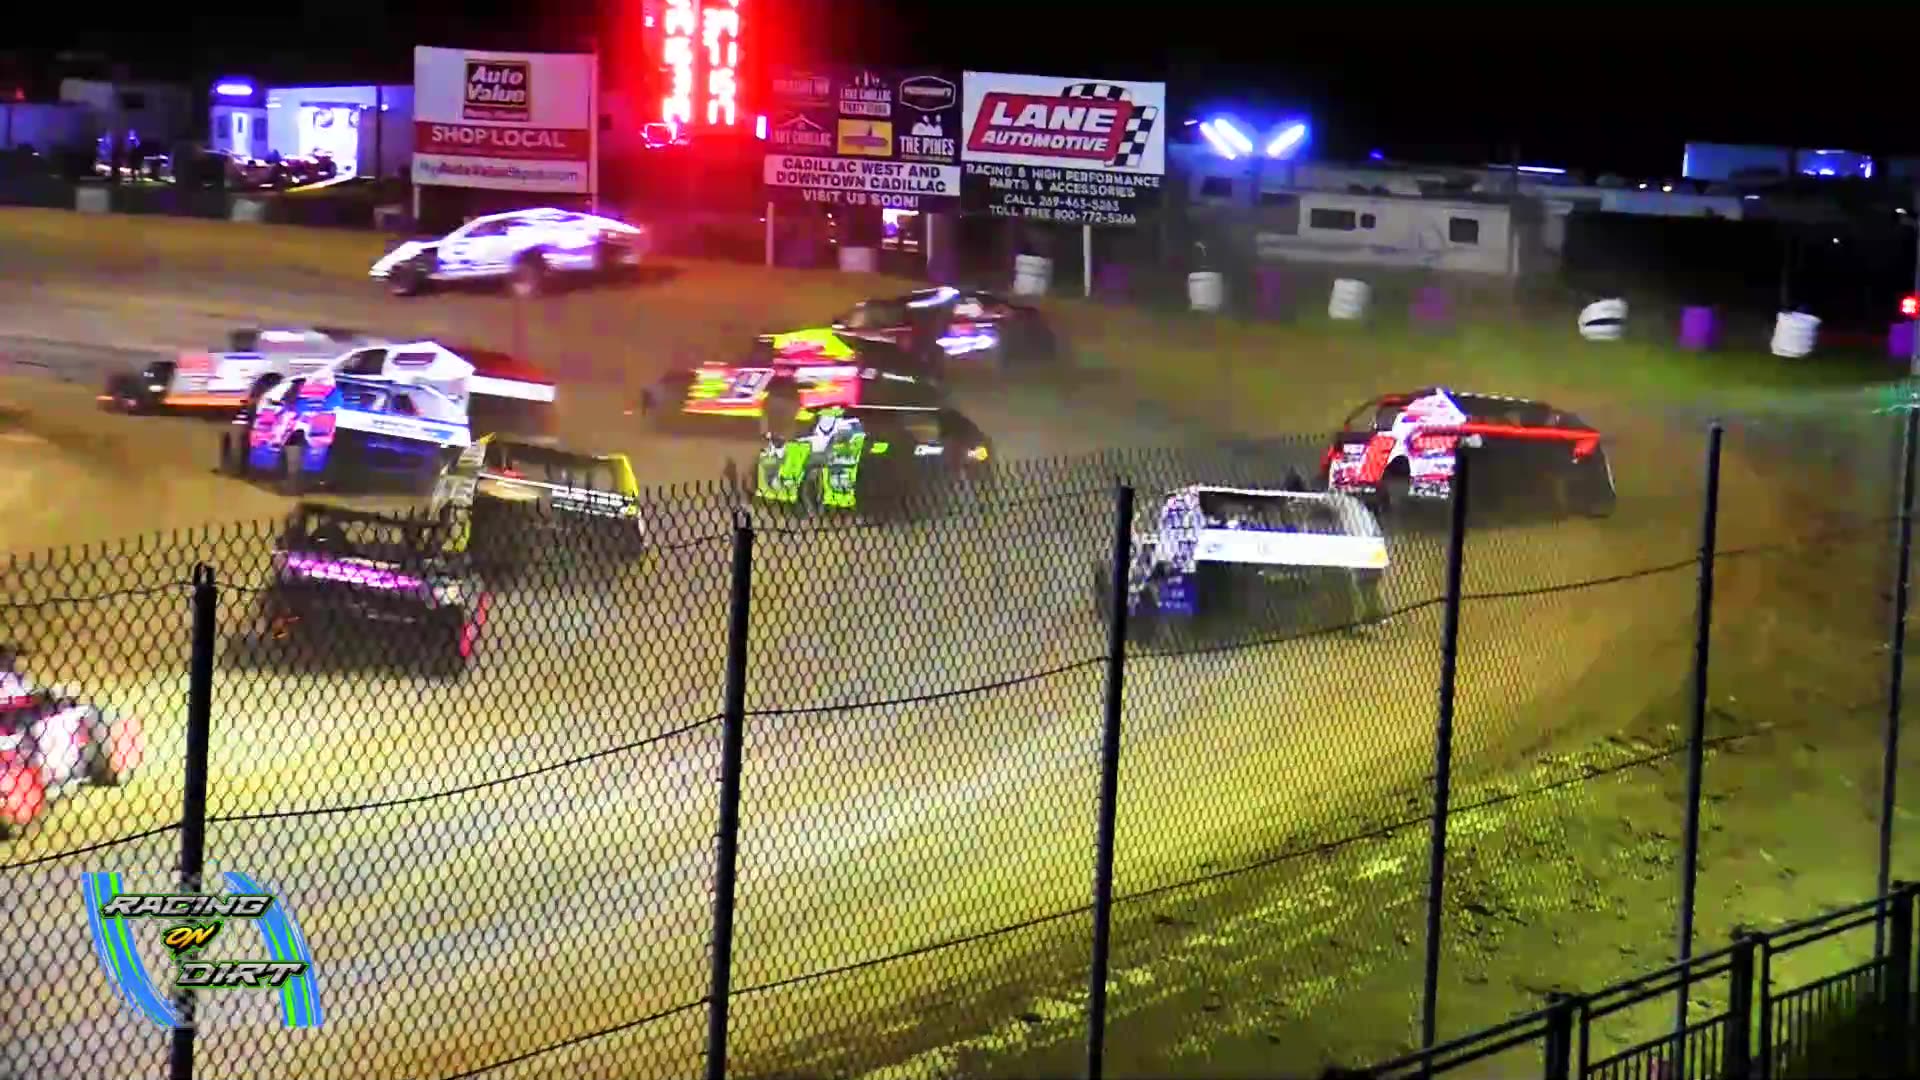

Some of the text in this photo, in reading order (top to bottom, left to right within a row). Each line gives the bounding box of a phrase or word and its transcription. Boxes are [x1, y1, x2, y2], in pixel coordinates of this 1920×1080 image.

[472, 66, 523, 84] Auto
[469, 84, 525, 102] Value
[990, 102, 1118, 133] LANE
[432, 125, 566, 148] SHOP LOCAL
[899, 136, 920, 154] THE
[922, 137, 955, 156] PINES
[981, 130, 1110, 152] AUTOMOTIVE
[783, 158, 940, 179] CADILLAC WEST AND
[966, 163, 1012, 177] RACING
[1032, 168, 1061, 180] HIGH
[1065, 170, 1160, 188] PERFORMANCE
[776, 171, 946, 193] DOWNTOWN CADILLAC
[989, 177, 1029, 190] PARTS
[1049, 181, 1136, 198] ACCESSORIES
[803, 189, 919, 208] VISIT US SOON!
[1004, 193, 1035, 206] CALL
[989, 204, 1018, 217] TOLL
[1024, 207, 1050, 219] FREE
